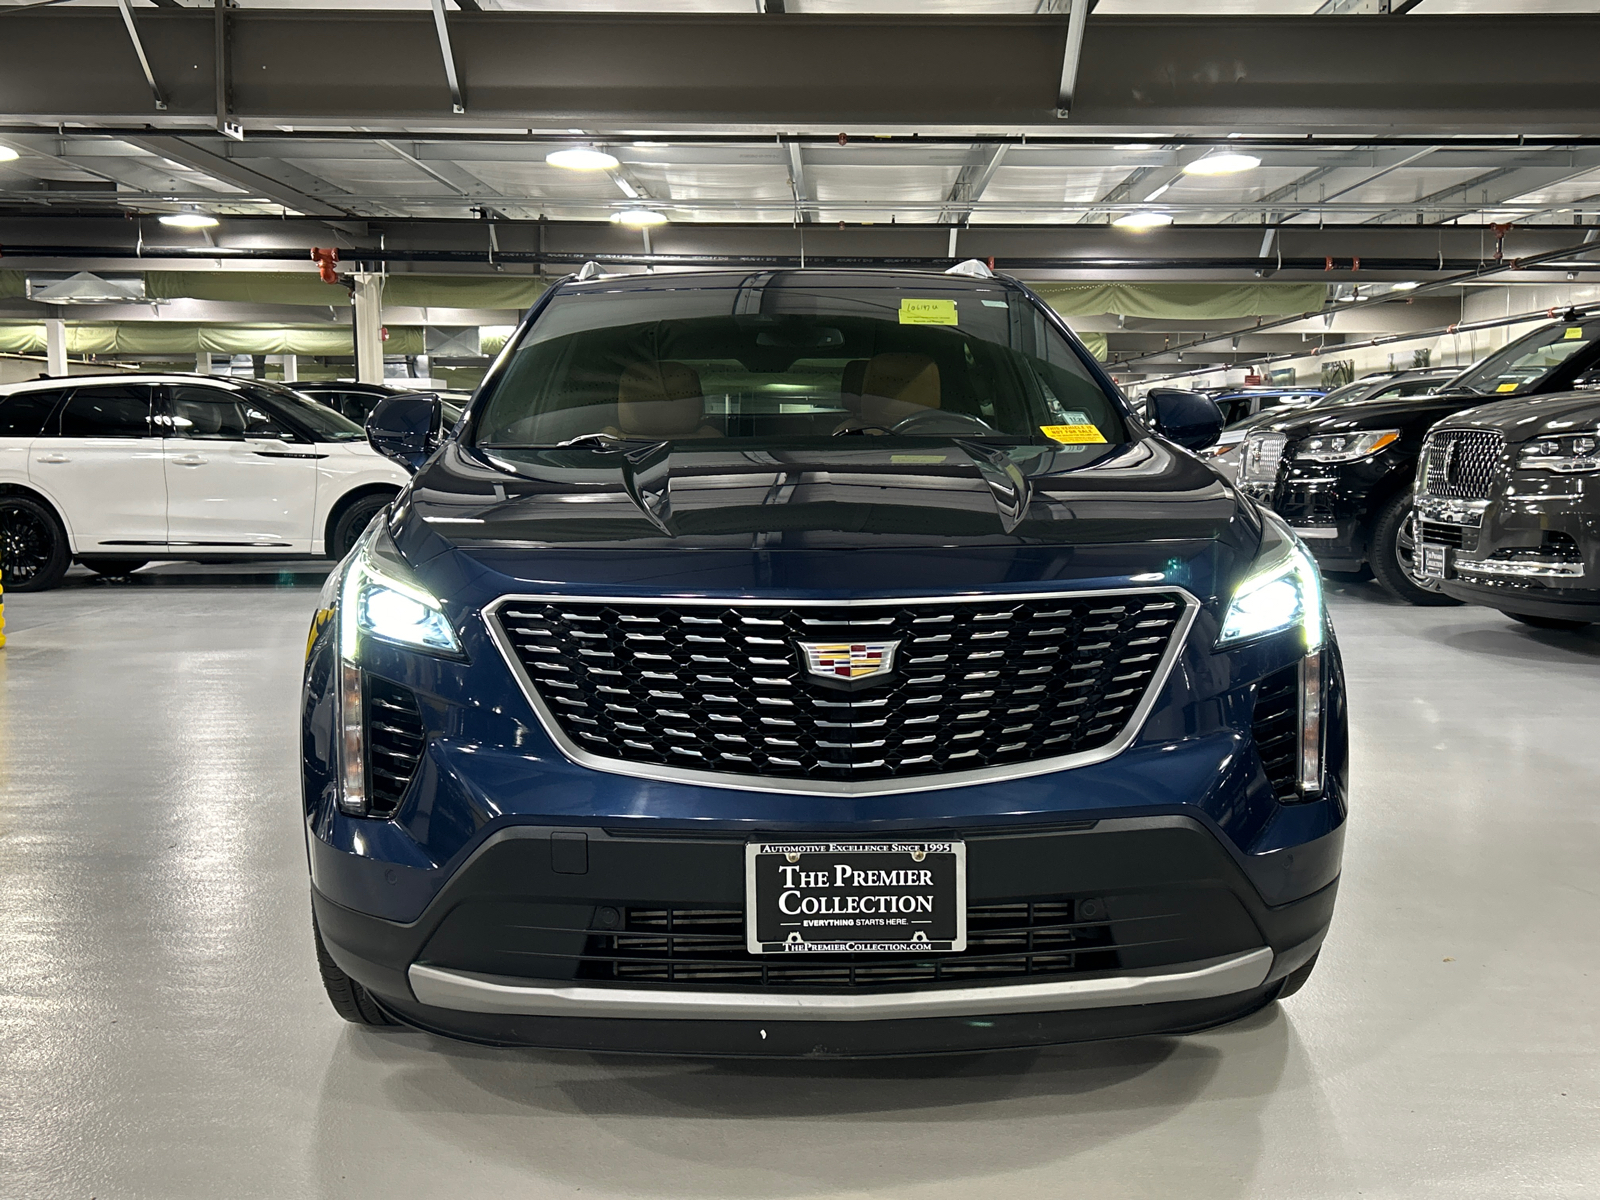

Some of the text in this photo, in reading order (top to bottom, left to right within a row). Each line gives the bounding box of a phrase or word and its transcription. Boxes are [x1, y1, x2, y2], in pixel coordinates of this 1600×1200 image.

[762, 842, 950, 853] AUTOMOTIVE EXCELLENCE SINCE 1995
[778, 864, 934, 888] THE PREMIER
[778, 890, 934, 915] COLLECTION
[803, 918, 909, 927] EVERYTHING STARTS HERE.
[782, 942, 932, 952] THEPREMIERCOLLECTION.COM
